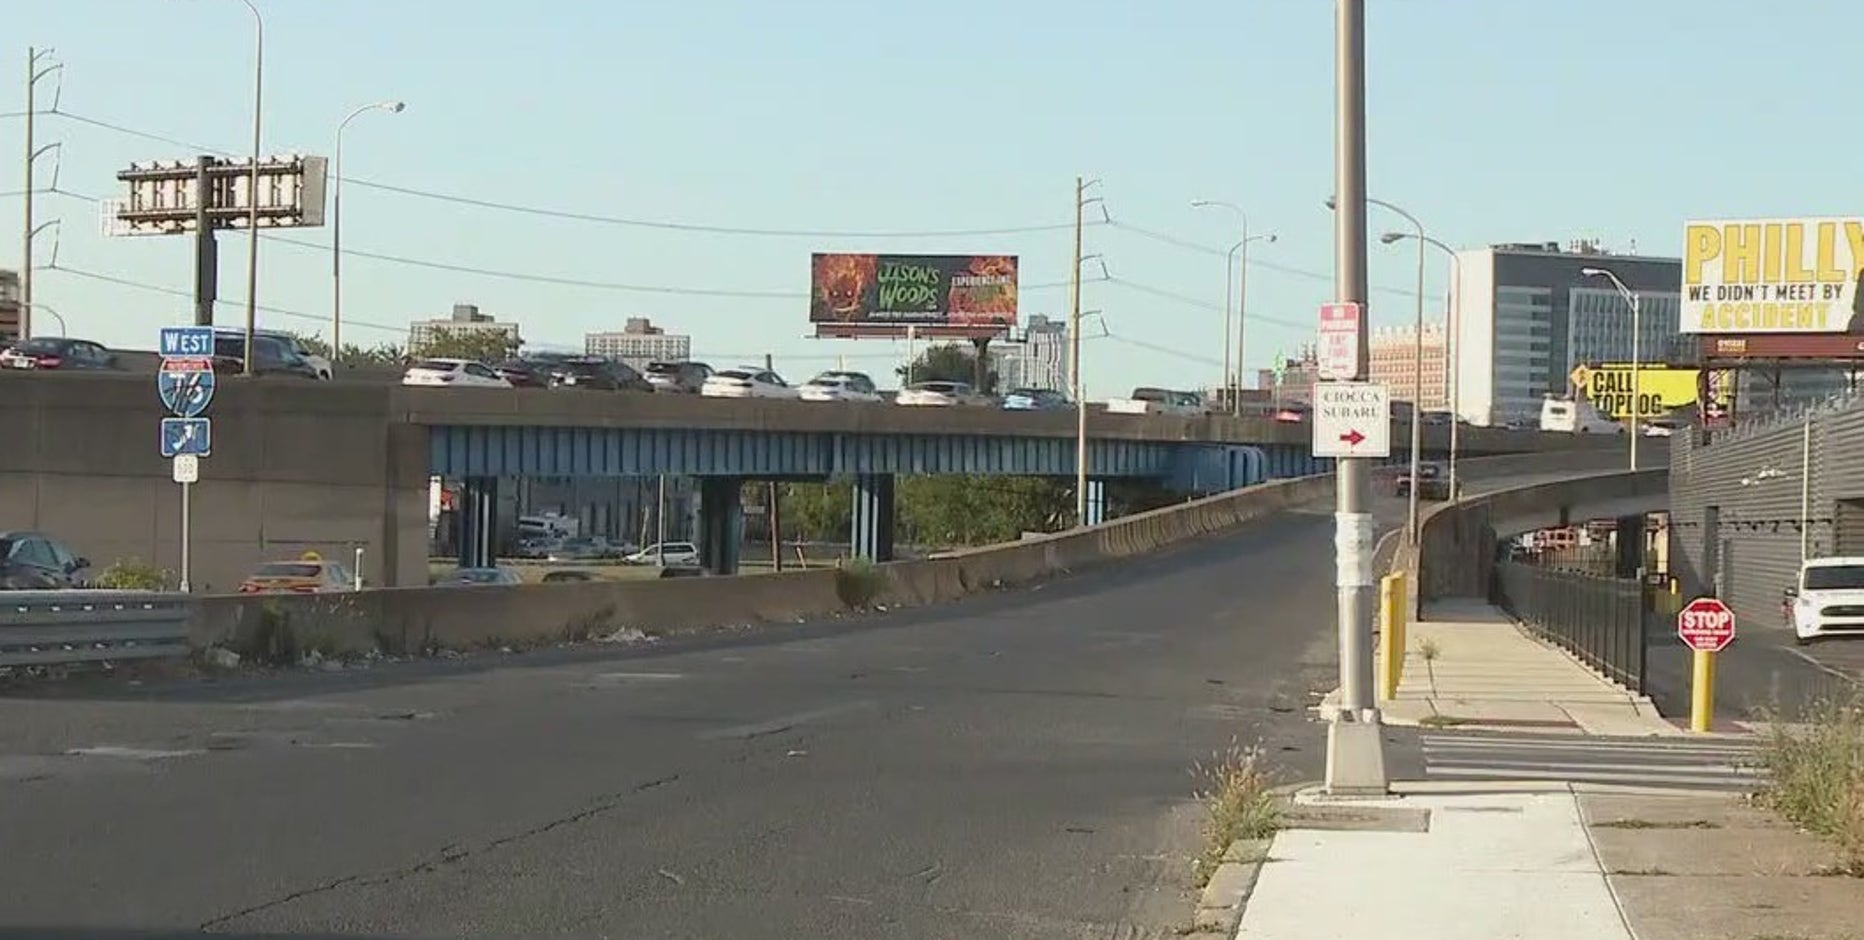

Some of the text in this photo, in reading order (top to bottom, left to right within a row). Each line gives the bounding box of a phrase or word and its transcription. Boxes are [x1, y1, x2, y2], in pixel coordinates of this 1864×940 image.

[1689, 284, 1843, 301] WE DIDN'T MEET BY
[1701, 303, 1830, 329] ACCIDENT
[165, 332, 209, 352] WEST
[1593, 372, 1633, 392] CALL
[1324, 391, 1380, 402] CIOCCA
[1324, 406, 1378, 418] SUBARU
[1684, 610, 1729, 629] STOP
